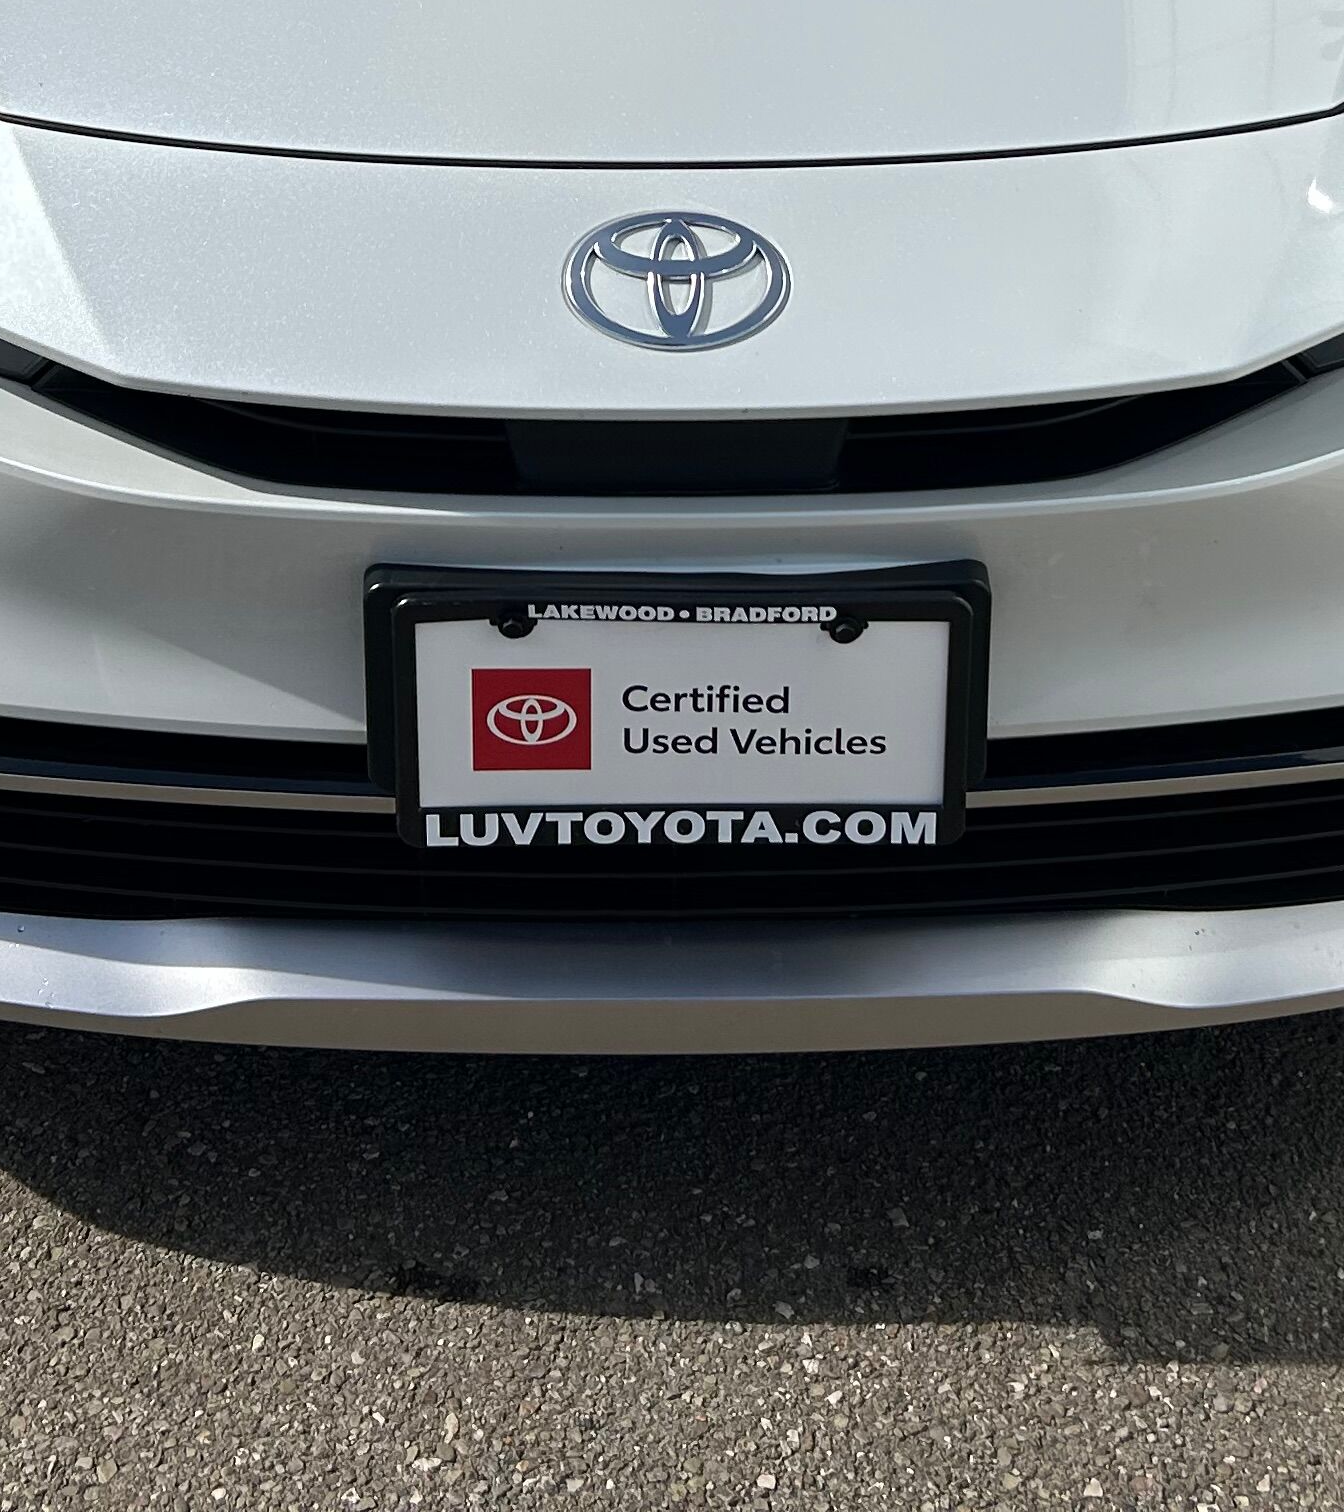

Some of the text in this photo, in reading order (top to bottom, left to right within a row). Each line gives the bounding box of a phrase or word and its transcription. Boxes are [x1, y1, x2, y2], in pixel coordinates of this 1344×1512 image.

[527, 603, 837, 624] LAKEWOOD BRADFORD
[621, 684, 790, 715] Certified
[622, 727, 887, 756] Used Vehicles
[425, 810, 938, 848] LUVTOYOTA.COM
